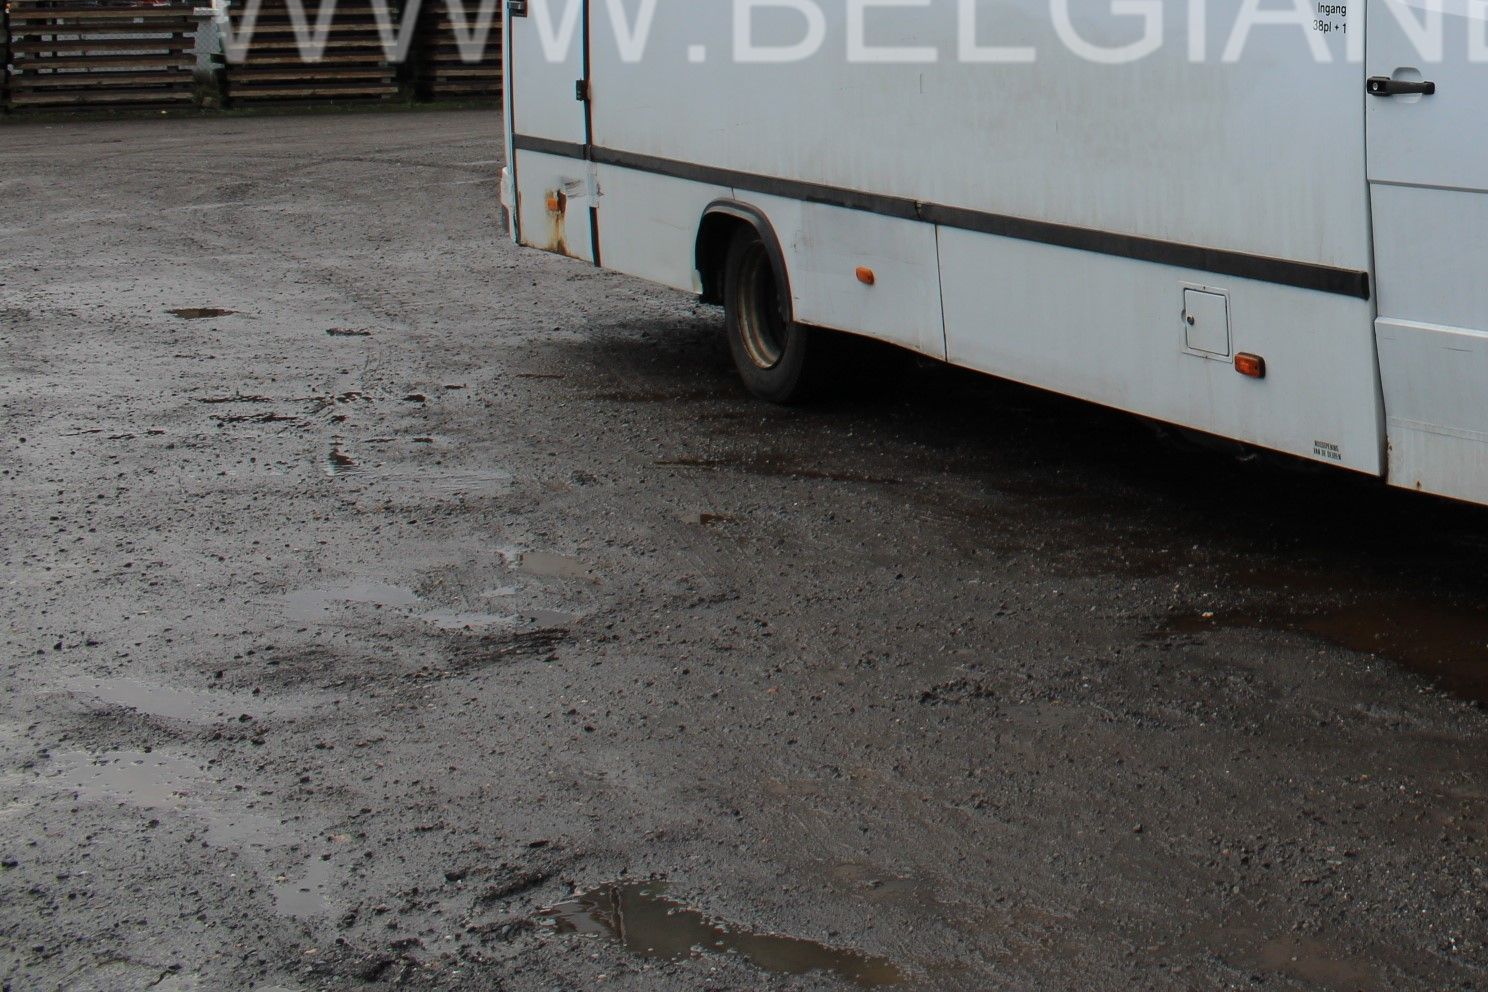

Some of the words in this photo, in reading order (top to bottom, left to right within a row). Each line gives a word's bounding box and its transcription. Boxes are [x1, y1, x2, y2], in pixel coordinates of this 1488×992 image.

[1317, 2, 1347, 17] Ingang
[1312, 19, 1332, 34] 38pl
[1342, 23, 1347, 34] 1
